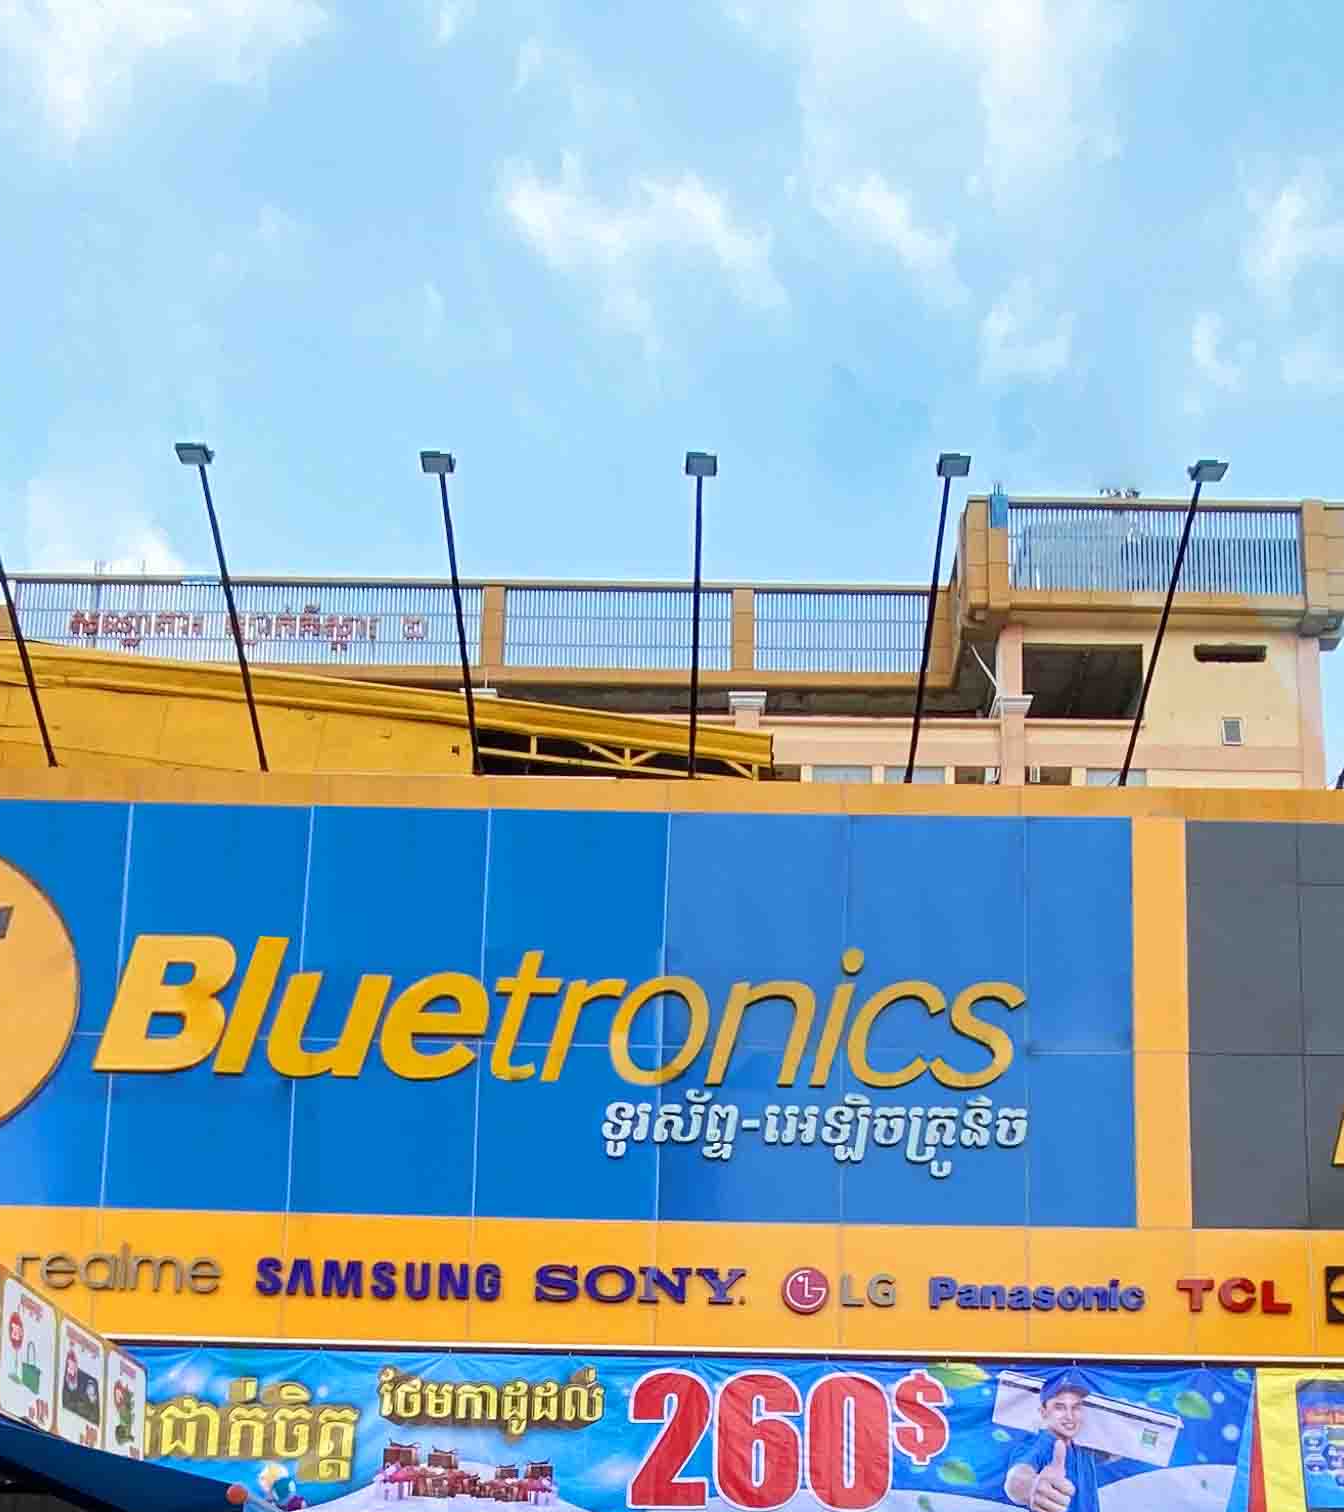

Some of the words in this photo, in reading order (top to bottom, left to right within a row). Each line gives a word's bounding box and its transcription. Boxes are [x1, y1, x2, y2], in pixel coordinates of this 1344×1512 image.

[93, 933, 1030, 1089] Bluetronics
[16, 1242, 222, 1295] realme
[256, 1257, 502, 1302] SAMSUNG
[535, 1264, 747, 1304] SONY
[840, 1274, 897, 1309] LG
[929, 1278, 1145, 1312] Panasonic
[1177, 1279, 1292, 1314] TCL
[144, 1377, 361, 1480] ជាក់ចិត្ត
